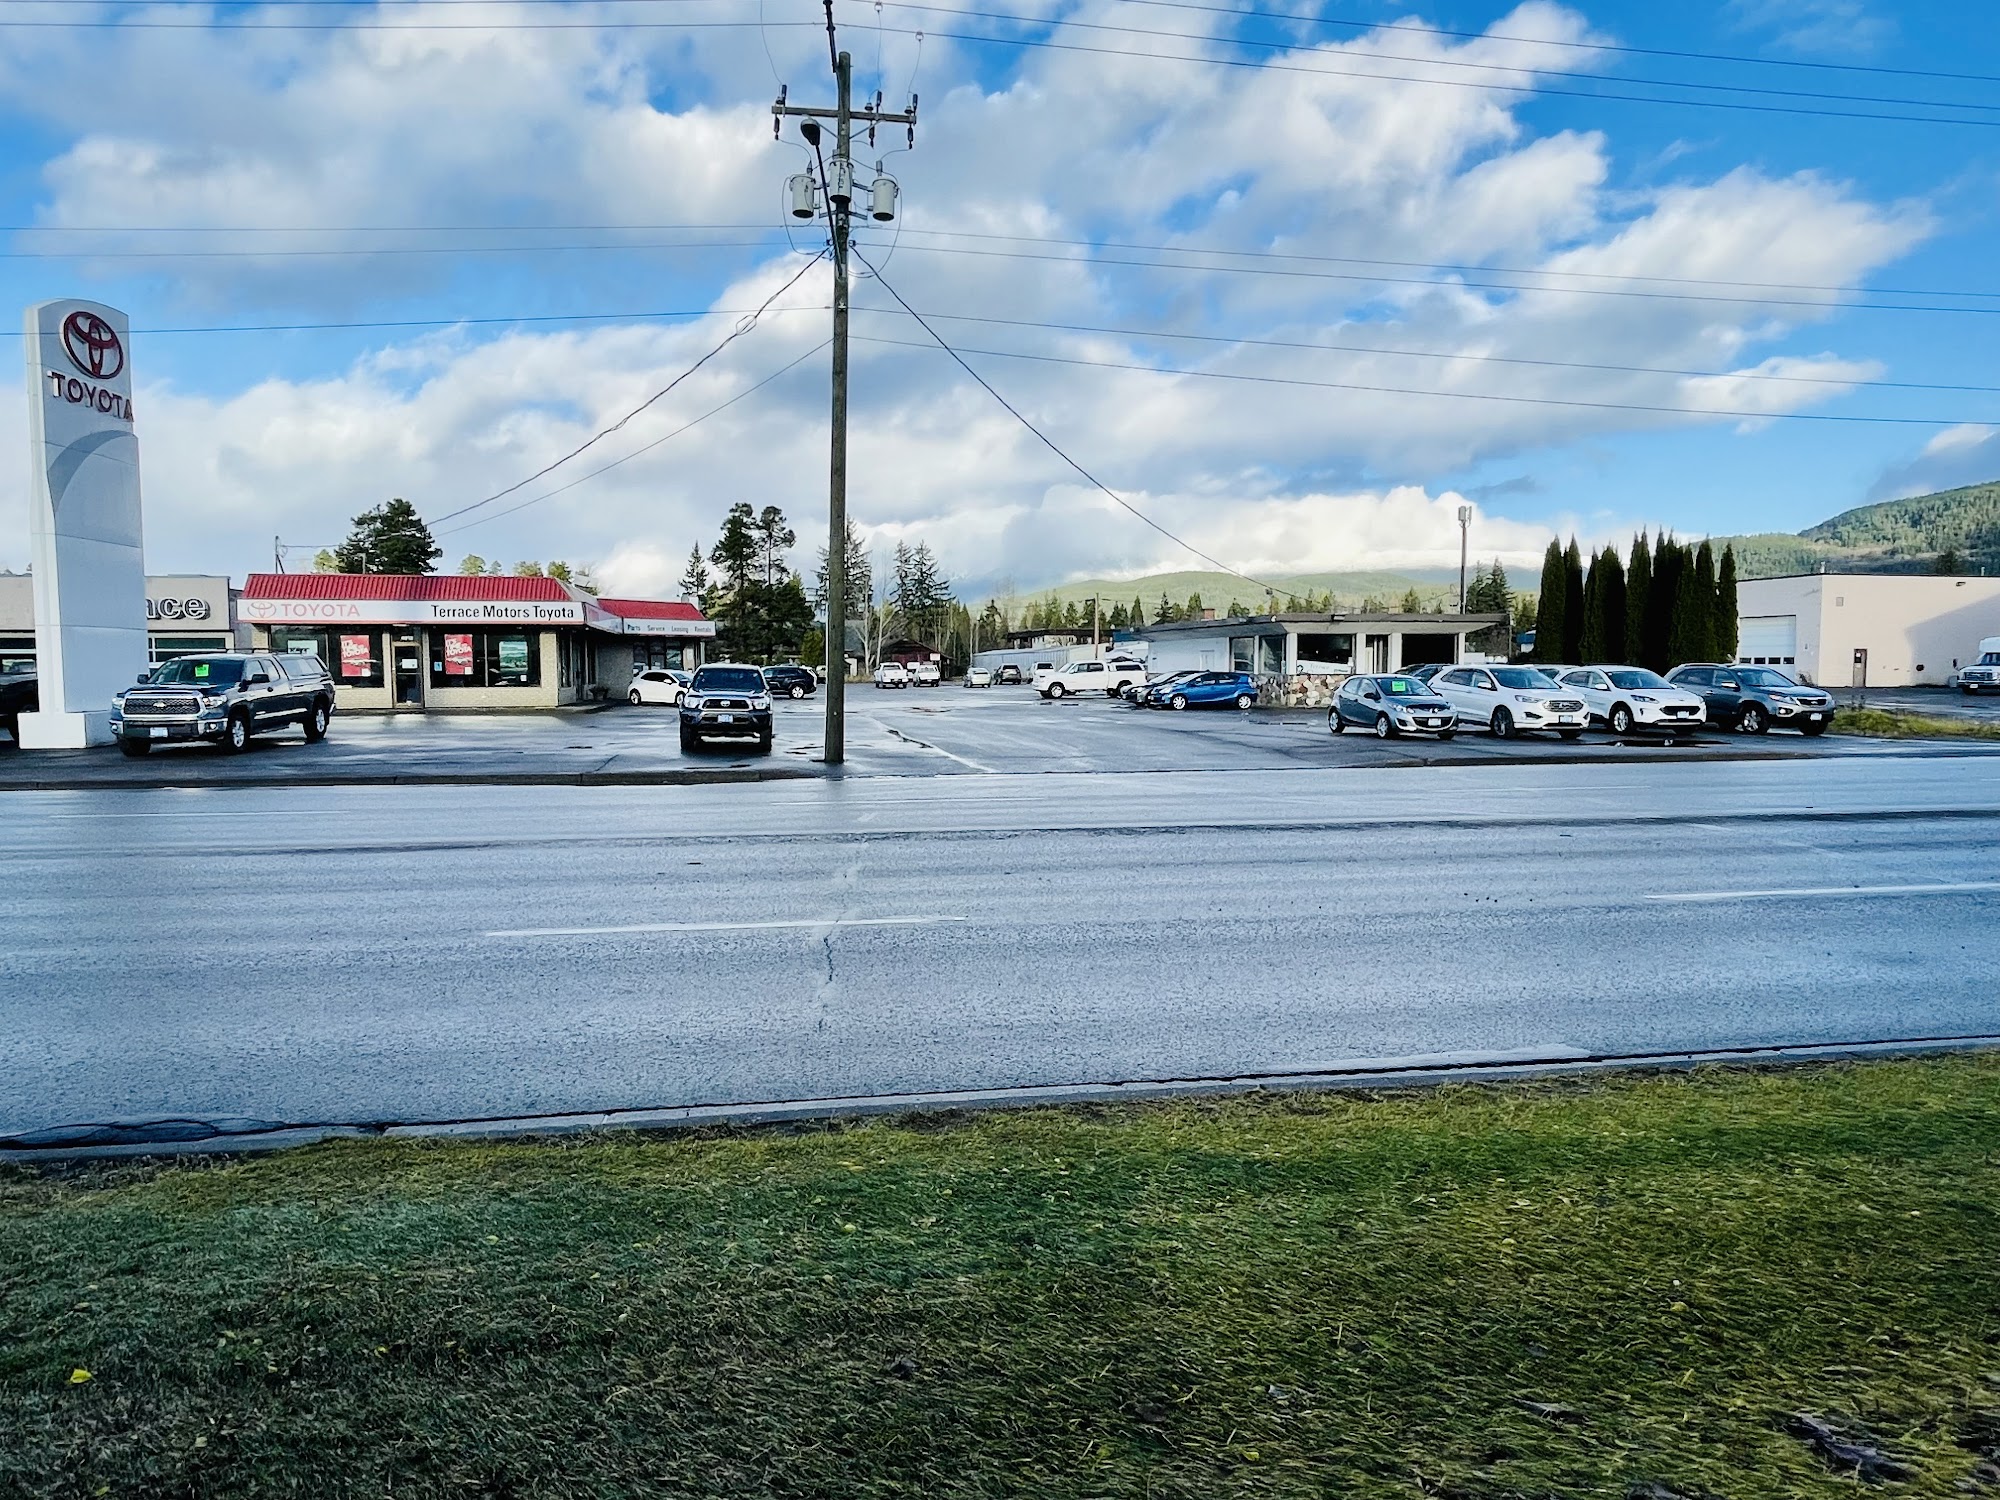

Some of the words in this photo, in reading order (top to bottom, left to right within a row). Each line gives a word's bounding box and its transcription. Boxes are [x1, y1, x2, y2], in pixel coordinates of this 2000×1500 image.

[47, 370, 134, 422] TOYOTA
[281, 603, 361, 617] TOYOTA
[431, 604, 480, 618] Terrace
[483, 605, 530, 618] Motors
[532, 605, 574, 621] Toyota
[627, 623, 641, 631] Parts
[647, 624, 665, 632] Service
[671, 625, 689, 634] Leasing
